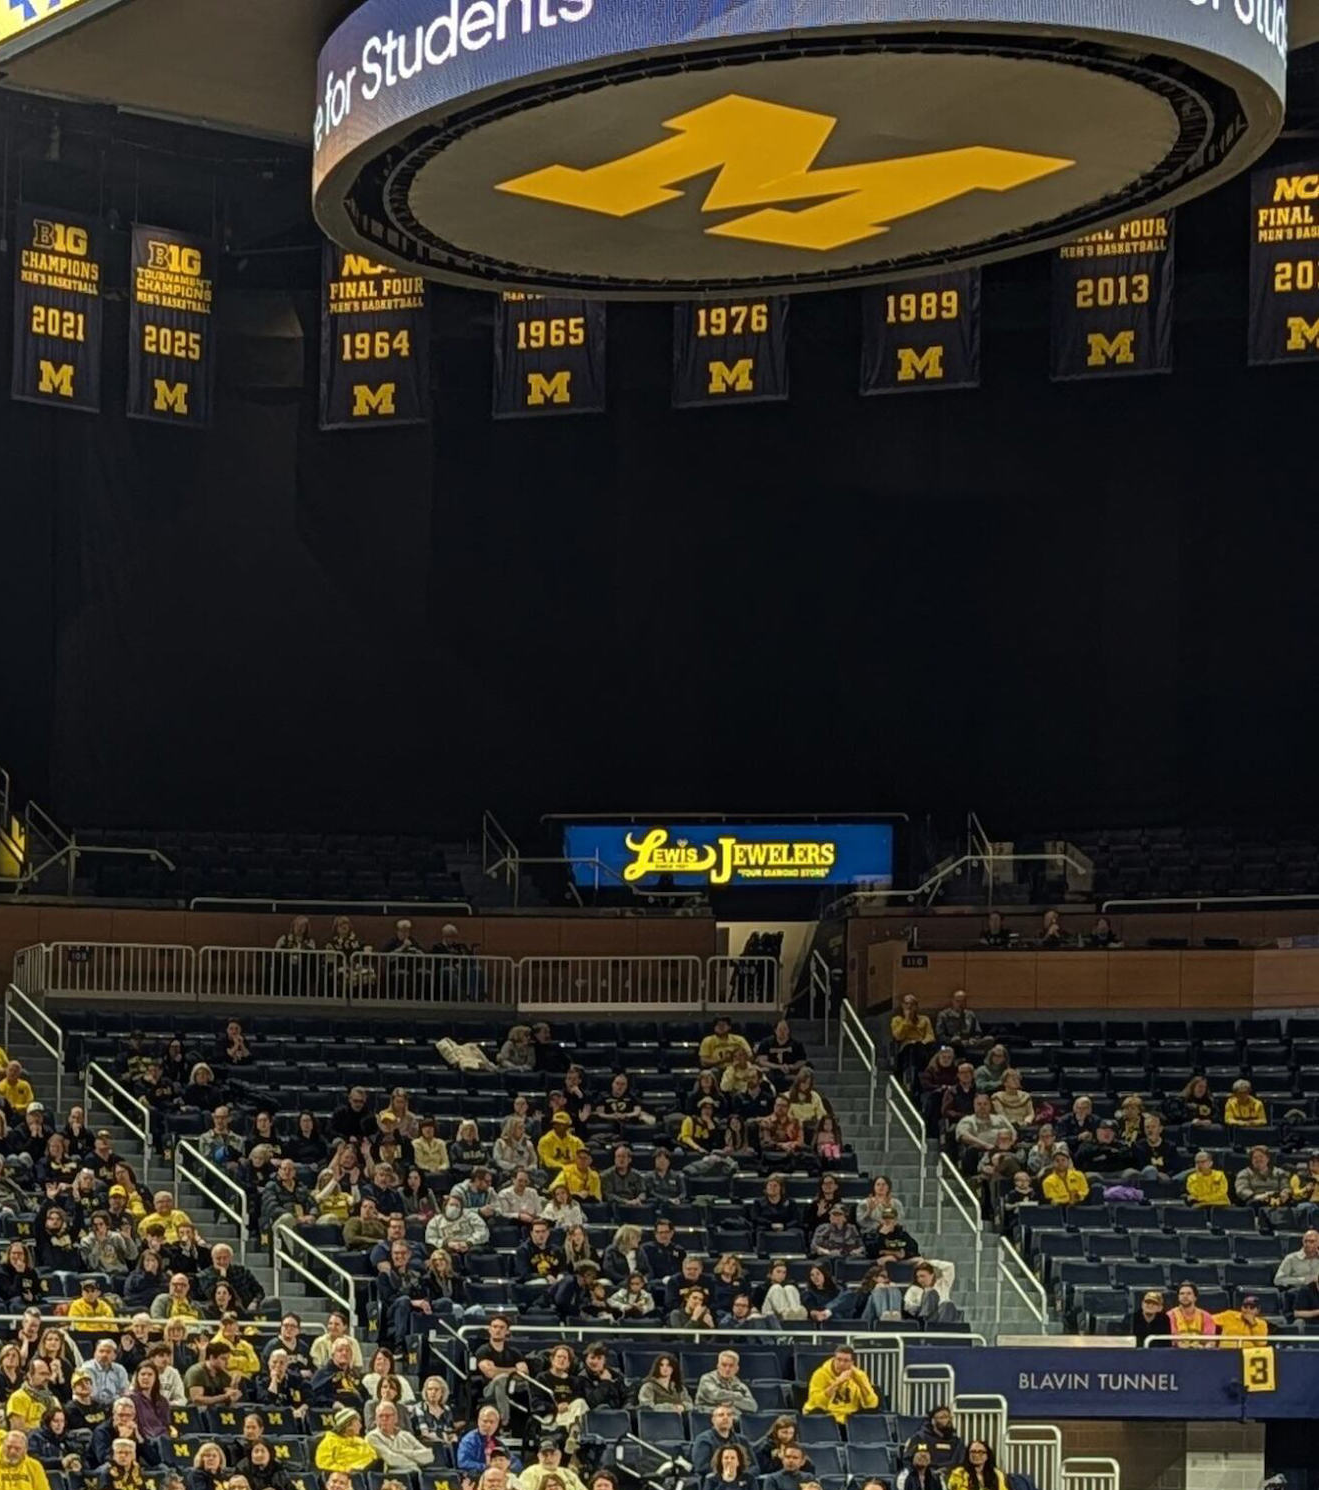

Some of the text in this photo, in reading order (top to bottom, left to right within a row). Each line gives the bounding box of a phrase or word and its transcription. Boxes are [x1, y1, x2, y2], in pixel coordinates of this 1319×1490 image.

[324, 66, 357, 136] for
[1272, 174, 1319, 202] NC
[1120, 217, 1168, 239] FOUR
[1257, 204, 1314, 228] FINAL
[1096, 239, 1167, 257] BASKETBALL
[1257, 227, 1293, 243] MEN'S
[21, 249, 100, 281] CHAMPIONS
[1273, 259, 1319, 293] 20
[136, 276, 213, 302] CHAMPIONS
[329, 277, 425, 300] FINAL FOUR
[1076, 273, 1150, 309] 2013
[31, 303, 85, 342] 2021
[697, 303, 768, 338] 1976
[886, 289, 959, 324] 1989
[144, 323, 202, 361] 2025
[342, 329, 410, 361] 1964
[517, 317, 585, 350] 1965
[1087, 329, 1135, 367] M
[1286, 316, 1319, 352] M
[38, 359, 75, 397] M
[708, 358, 754, 395] M
[897, 345, 944, 382] M
[153, 378, 189, 415] M
[352, 382, 396, 417] M
[527, 370, 571, 406] M
[709, 837, 836, 884] JEWELERS
[1018, 1372, 1179, 1391] BLAVIN TUNNEL
[1249, 1356, 1270, 1386] 3
